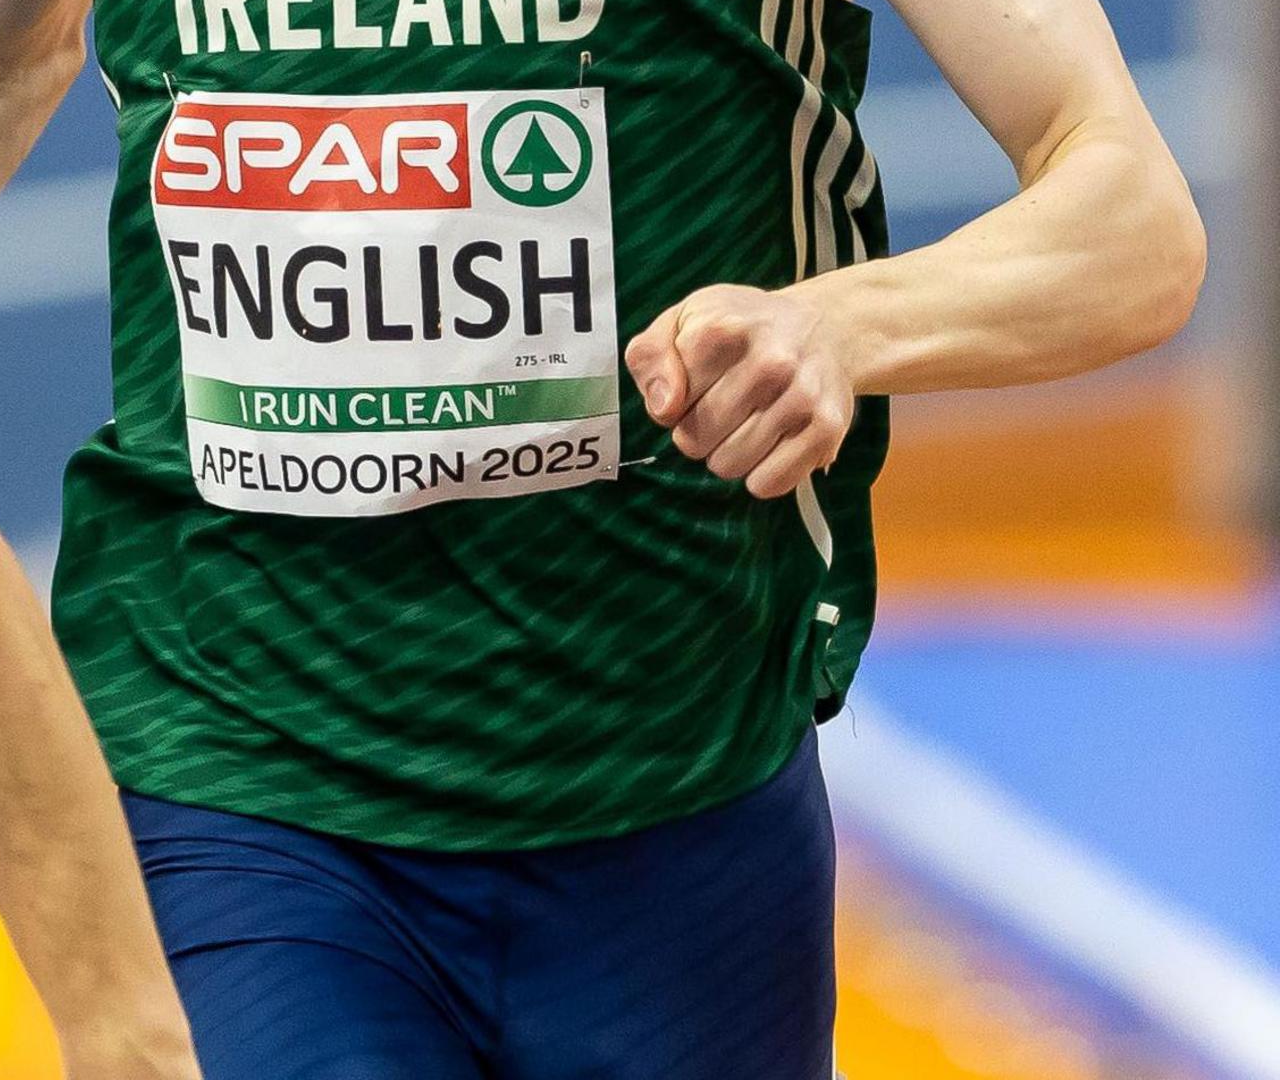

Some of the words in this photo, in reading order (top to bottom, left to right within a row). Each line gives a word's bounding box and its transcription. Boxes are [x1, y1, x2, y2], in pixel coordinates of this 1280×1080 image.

[160, 116, 461, 195] SPAR
[167, 237, 594, 344] ENGLISH
[514, 355, 538, 368] 275
[548, 353, 568, 366] IRL
[238, 390, 248, 423] I
[253, 391, 338, 427] RUN
[200, 443, 466, 494] APELDOORN
[480, 436, 602, 484] 2025
